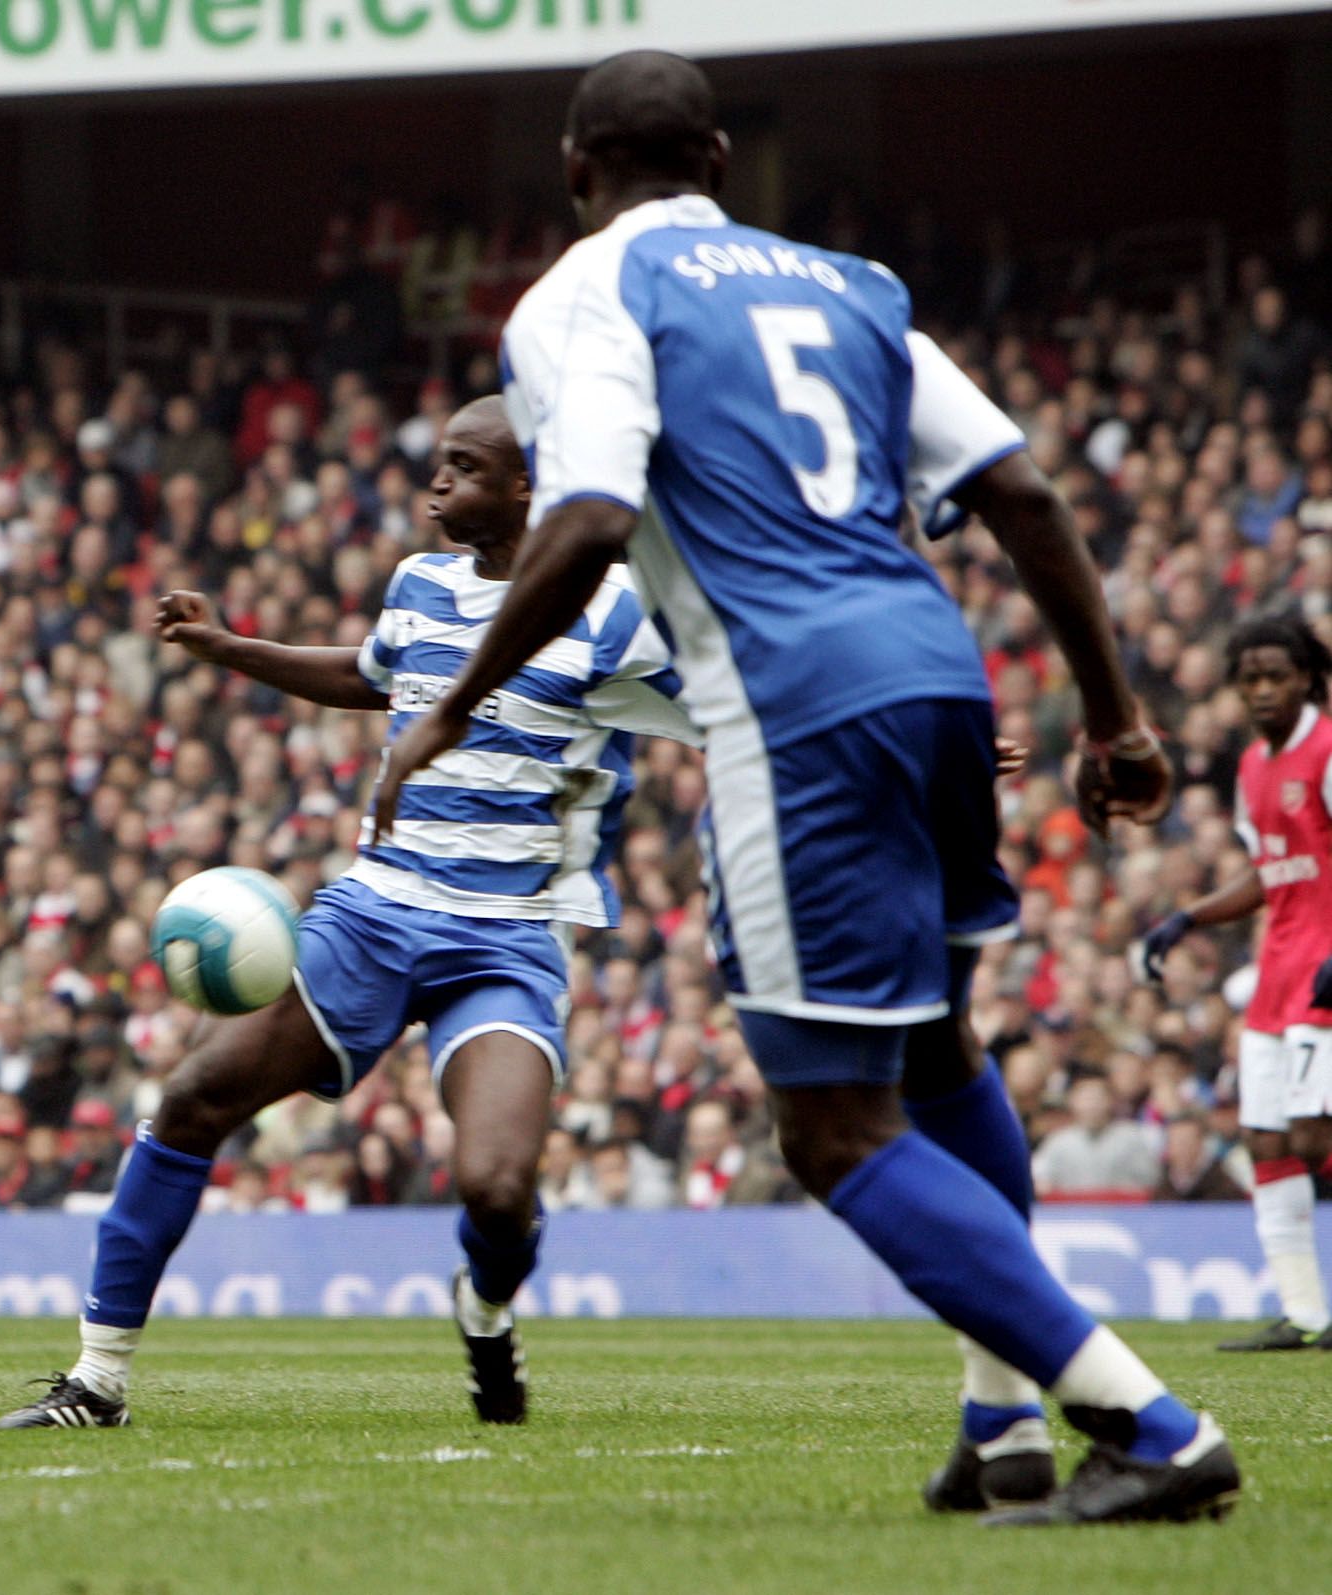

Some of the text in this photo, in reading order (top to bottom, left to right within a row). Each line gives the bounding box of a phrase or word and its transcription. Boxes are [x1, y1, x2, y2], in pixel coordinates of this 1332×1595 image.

[673, 242, 846, 290] SONKO
[747, 304, 858, 519] 5
[1297, 1042, 1316, 1083] 7
[320, 1270, 625, 1318] son
